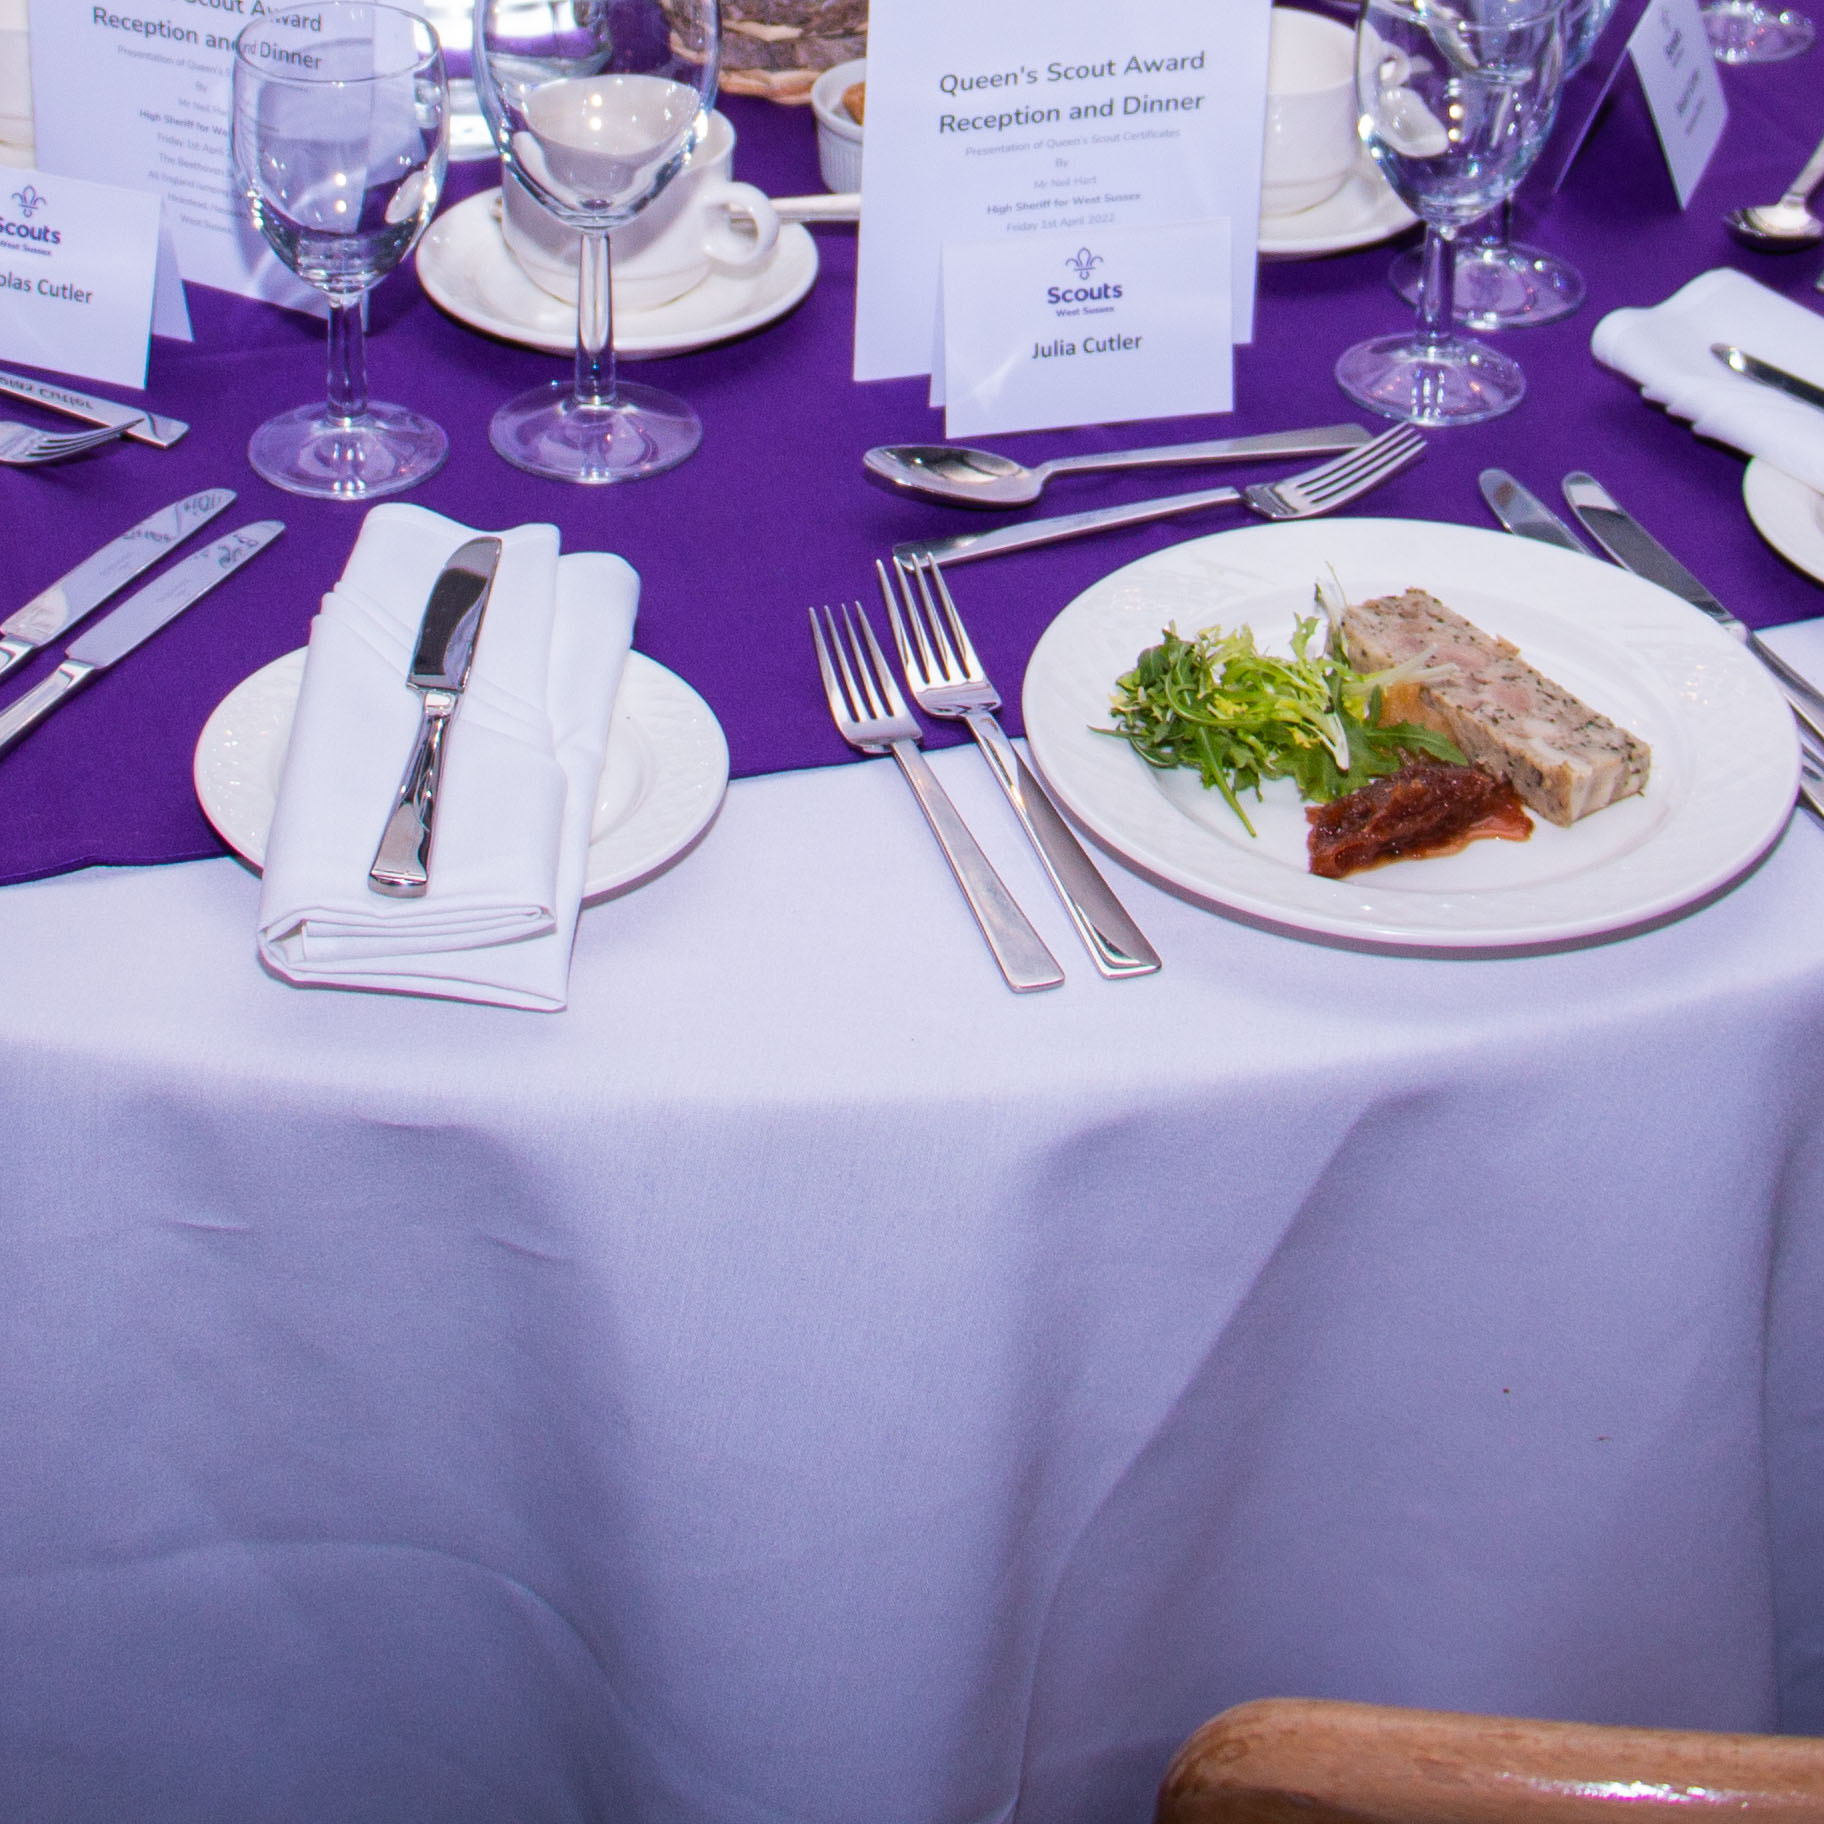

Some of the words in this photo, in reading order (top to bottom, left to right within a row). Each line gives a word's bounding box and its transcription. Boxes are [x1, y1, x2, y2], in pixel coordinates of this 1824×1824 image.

[92, 6, 198, 45] Reception
[259, 42, 324, 70] Dinner
[939, 65, 1039, 97] Queen's
[1047, 58, 1117, 82] Scout
[1123, 50, 1206, 76] Award
[939, 105, 1061, 134] Reception
[1069, 97, 1114, 121] and
[1122, 93, 1206, 116] Dinner
[965, 141, 1030, 157] Presentation
[1033, 139, 1044, 150] of
[1046, 135, 1088, 150] Queen's
[1091, 133, 1121, 145] Scout
[1122, 128, 1182, 142] Certificates
[1054, 157, 1069, 169] By
[986, 203, 1012, 216] High
[1015, 199, 1052, 212] Sheriff
[1054, 197, 1069, 208] for
[1072, 194, 1100, 206] West
[1104, 191, 1142, 203] Sussex
[1007, 220, 1038, 233] Friday
[1041, 219, 1056, 229] 1st
[1060, 215, 1085, 228] April
[37, 278, 93, 304] Cutler
[1047, 282, 1123, 305] Scouts
[1056, 307, 1080, 317] West
[1083, 305, 1115, 315] Sussex
[1032, 339, 1076, 360] Julia
[1083, 333, 1143, 355] Cutler
